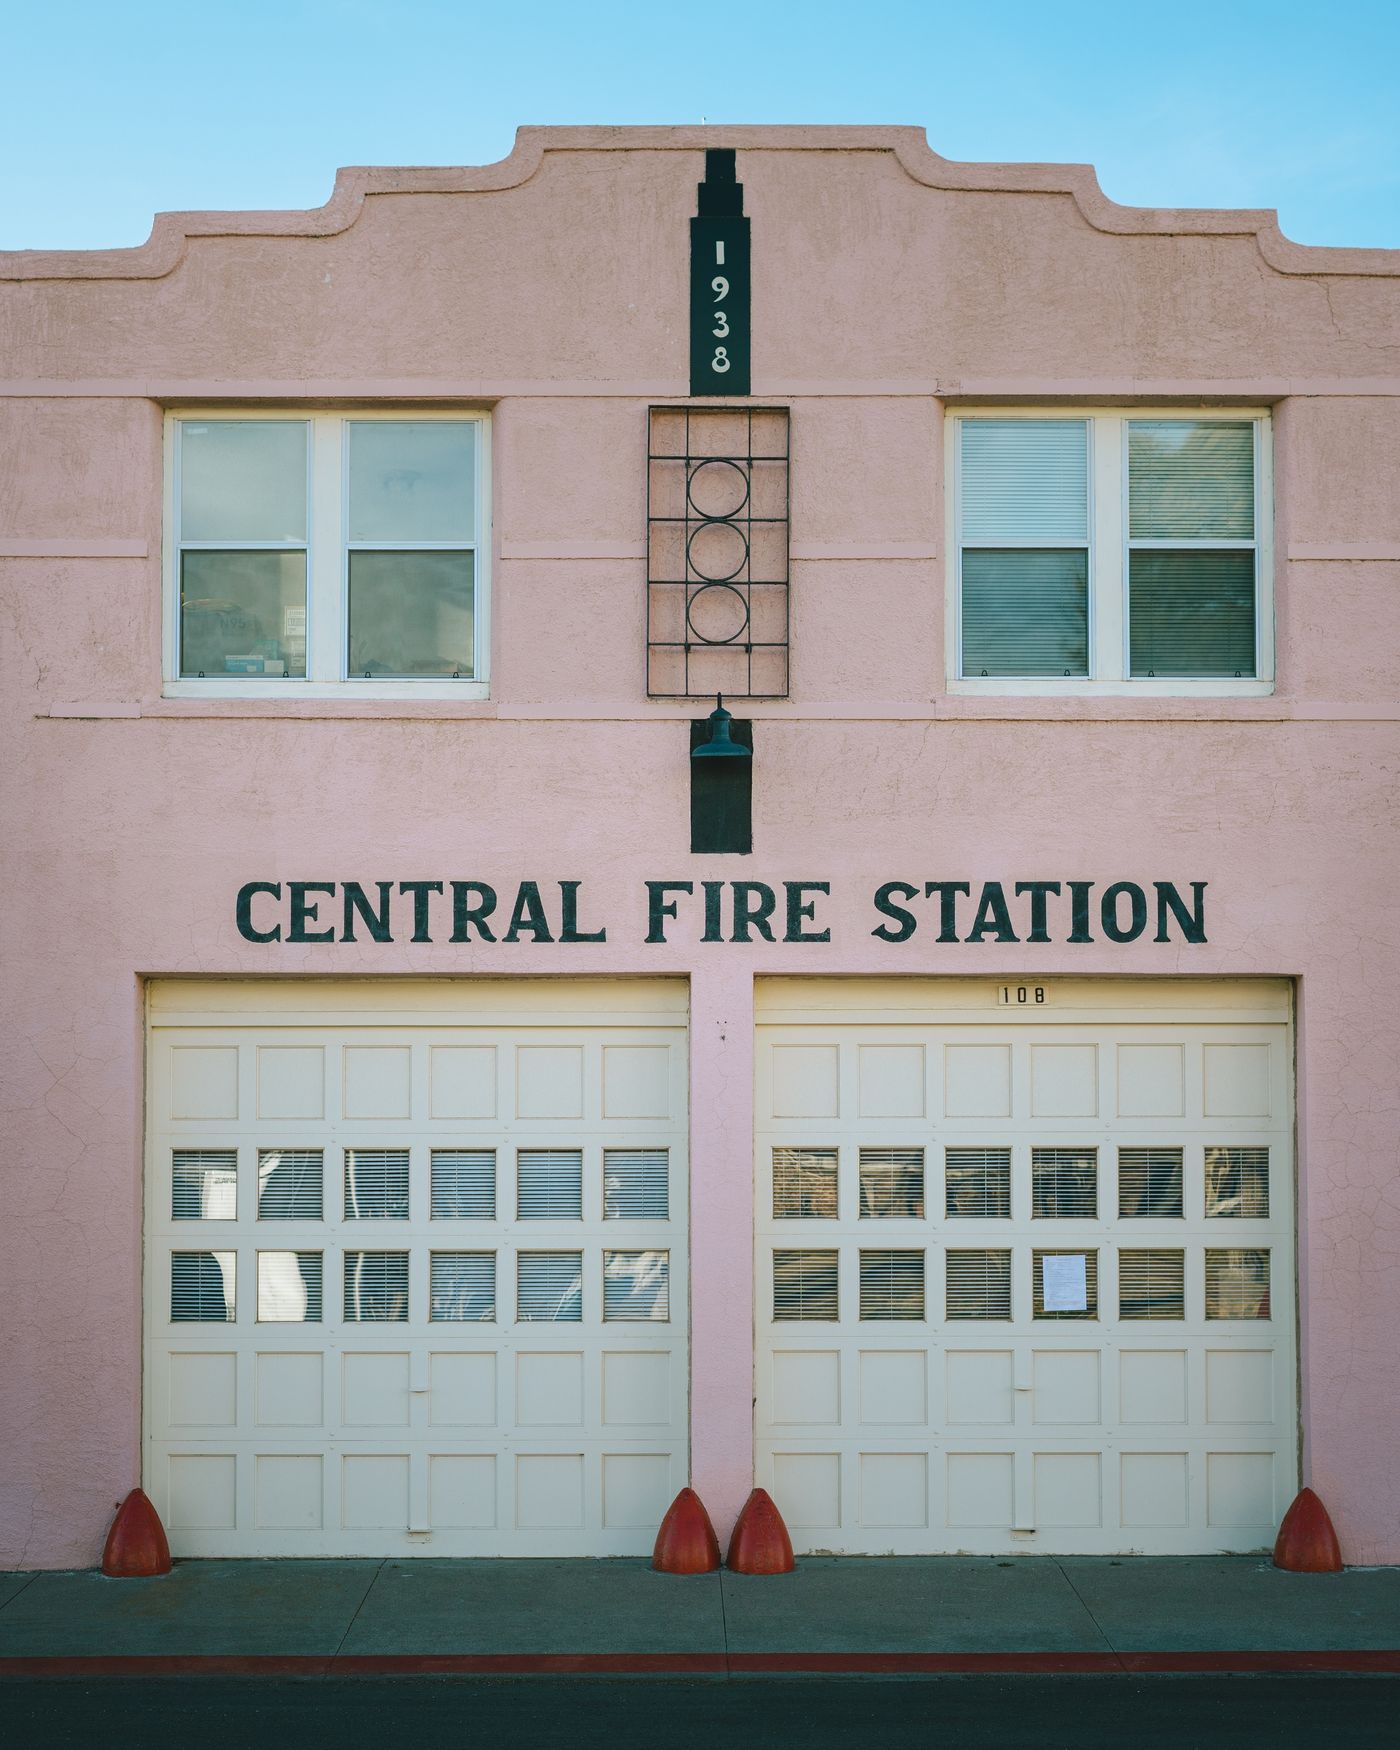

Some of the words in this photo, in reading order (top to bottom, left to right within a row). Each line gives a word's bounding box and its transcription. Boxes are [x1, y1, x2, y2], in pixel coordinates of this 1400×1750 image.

[711, 240, 731, 374] 1938
[235, 881, 606, 944] CENTRAL
[644, 881, 831, 944] FIRE
[871, 881, 1209, 944] STATION
[1003, 986, 1045, 1004] 108
